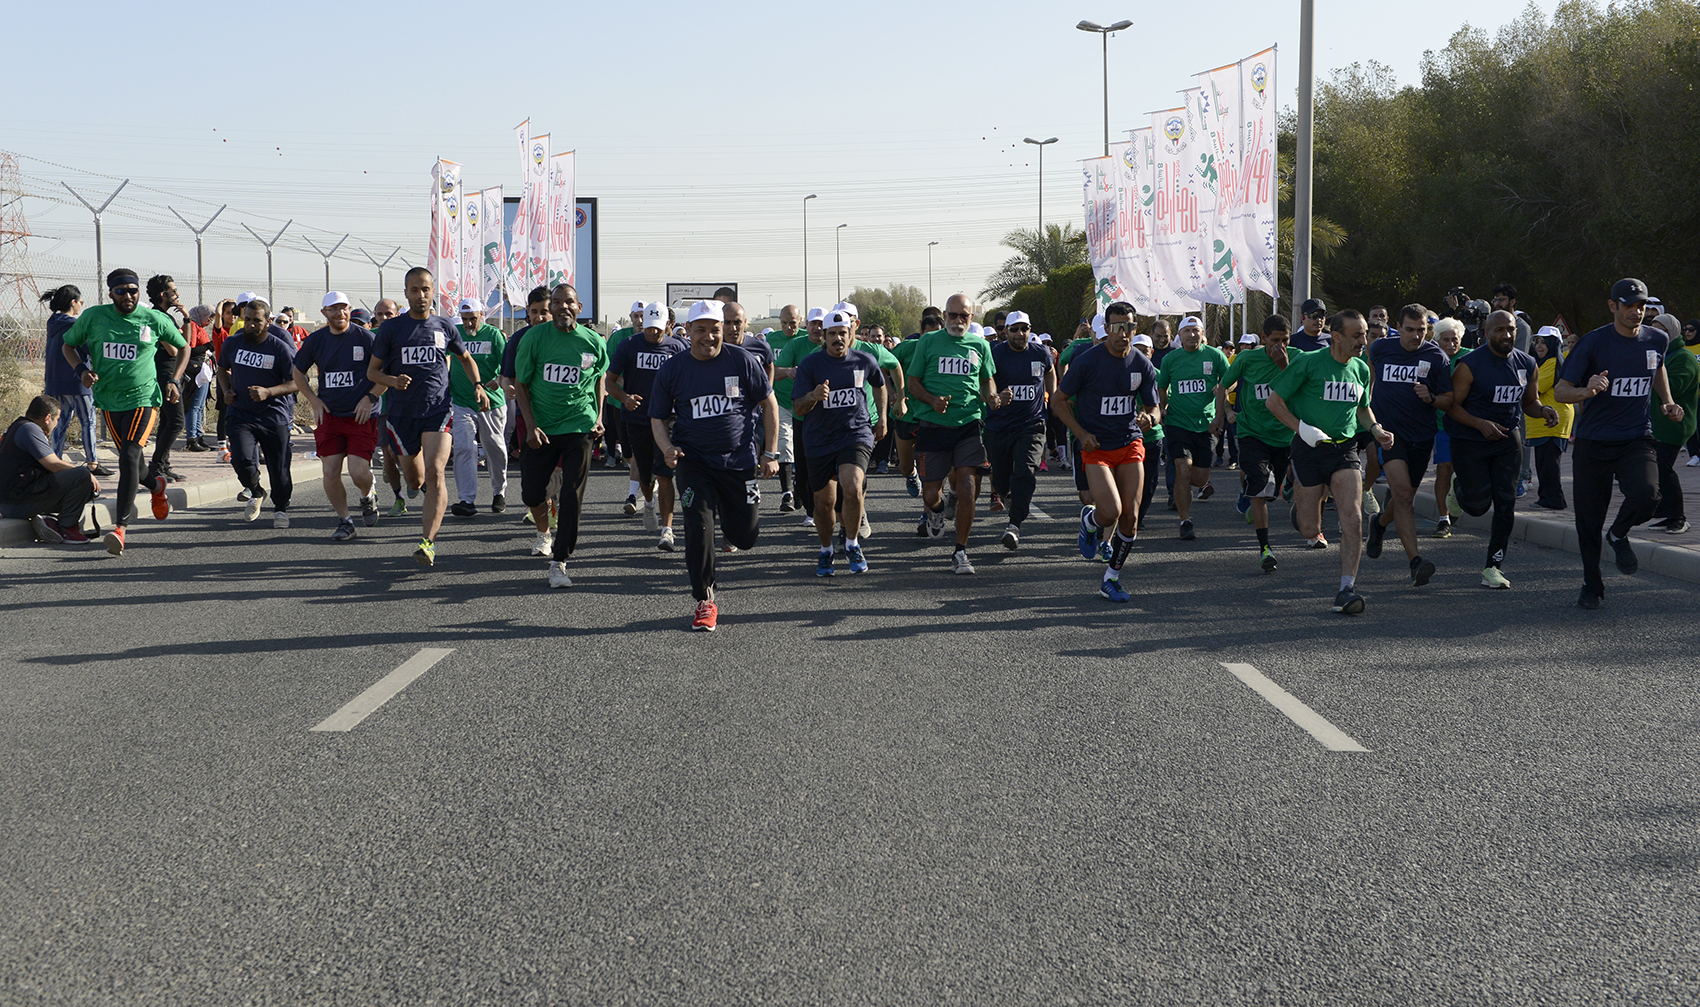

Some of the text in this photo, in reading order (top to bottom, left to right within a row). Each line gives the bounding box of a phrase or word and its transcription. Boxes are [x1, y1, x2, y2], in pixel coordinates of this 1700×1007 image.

[104, 343, 137, 360] 1105
[403, 346, 436, 363] 1420
[464, 341, 482, 354] 107
[237, 349, 263, 368] 1403
[638, 353, 666, 369] 1408
[940, 358, 970, 374] 1116
[326, 372, 352, 387] 1424
[545, 364, 579, 384] 1123
[1385, 365, 1416, 382] 1404
[1011, 385, 1035, 400] 1416
[1180, 380, 1206, 394] 1103
[1327, 382, 1356, 401] 1114
[1496, 385, 1523, 403] 1412
[1614, 378, 1649, 397] 1417
[694, 395, 733, 417] 1402
[828, 390, 855, 407] 1423
[1103, 396, 1132, 414] 1411
